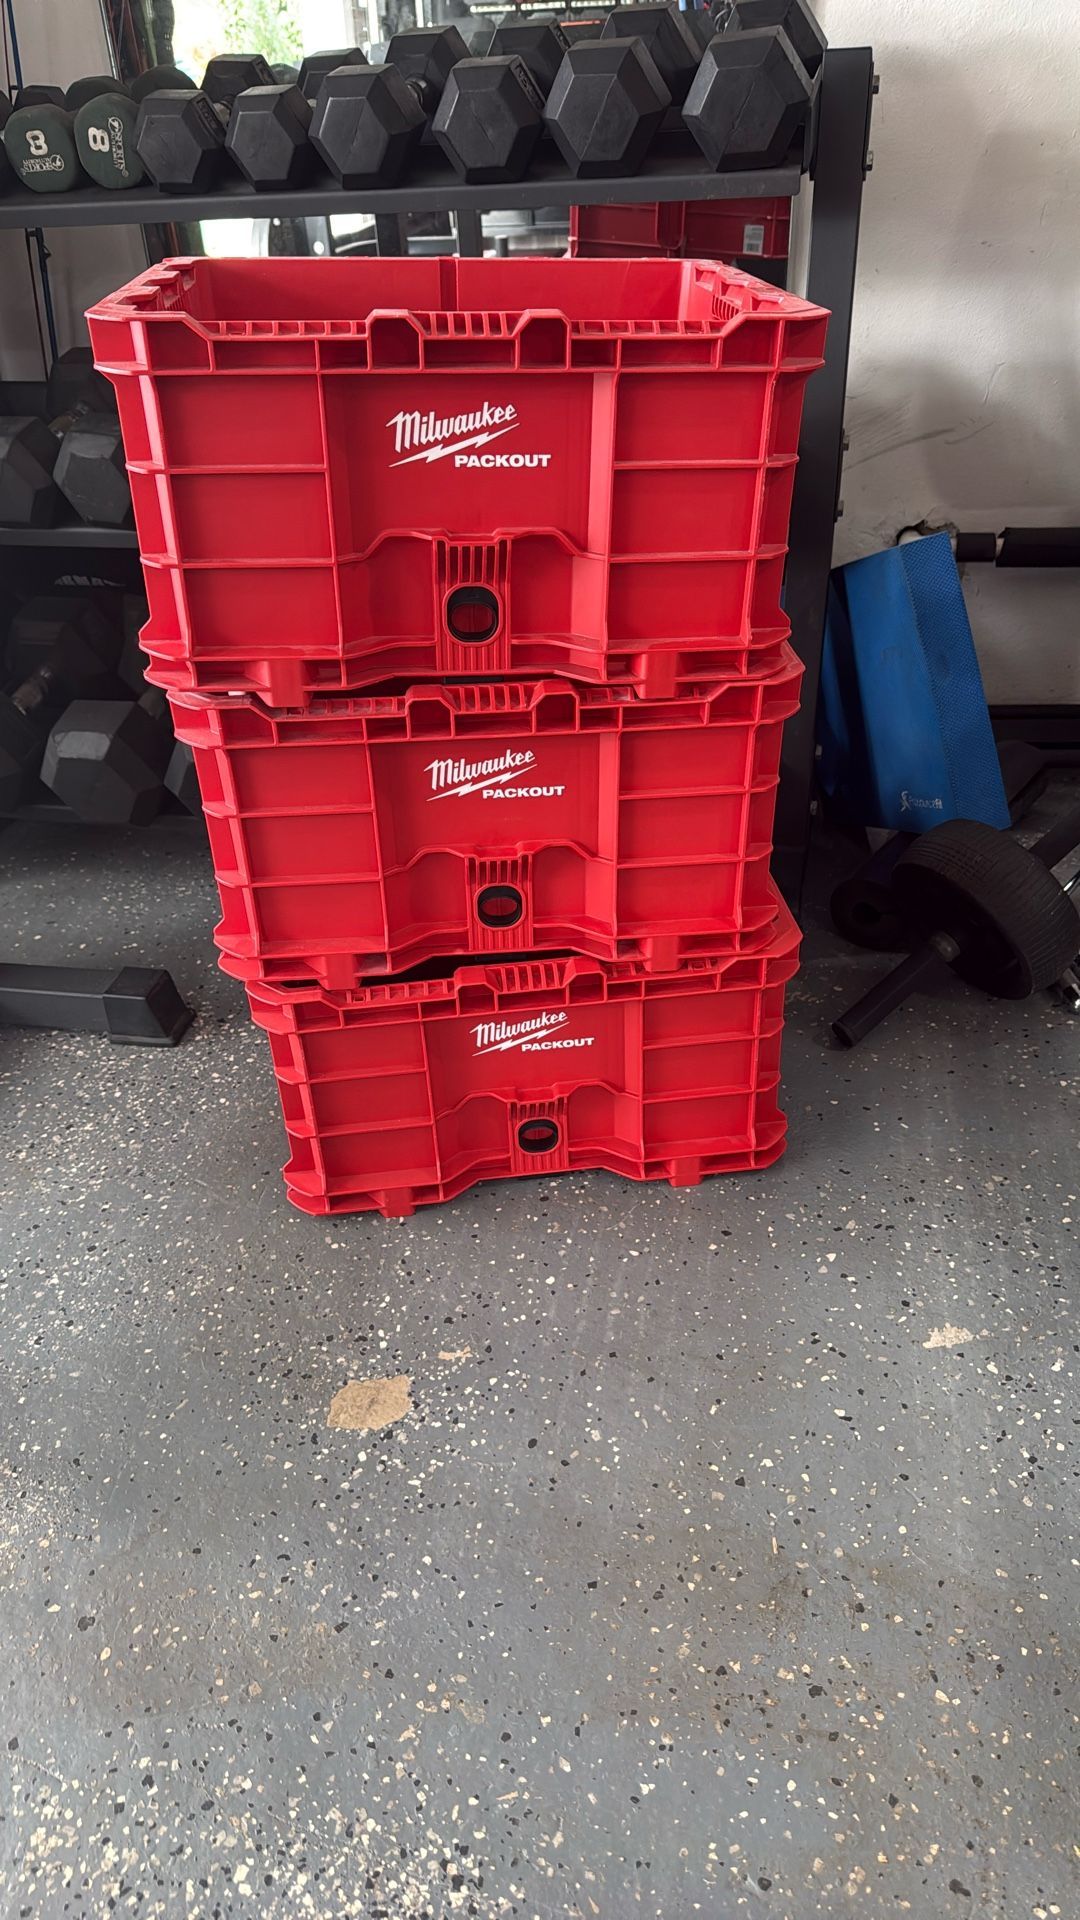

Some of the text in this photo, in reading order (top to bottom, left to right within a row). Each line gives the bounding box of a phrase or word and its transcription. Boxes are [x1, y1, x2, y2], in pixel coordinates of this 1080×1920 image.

[88, 127, 110, 152] 8
[386, 401, 518, 453] Milwaukee
[454, 454, 552, 468] PACKOUT
[423, 749, 536, 791] Milwaukee
[482, 785, 566, 800] PACKOUT
[469, 1011, 568, 1048] Milwaukee
[521, 1037, 595, 1052] PACKOUT
